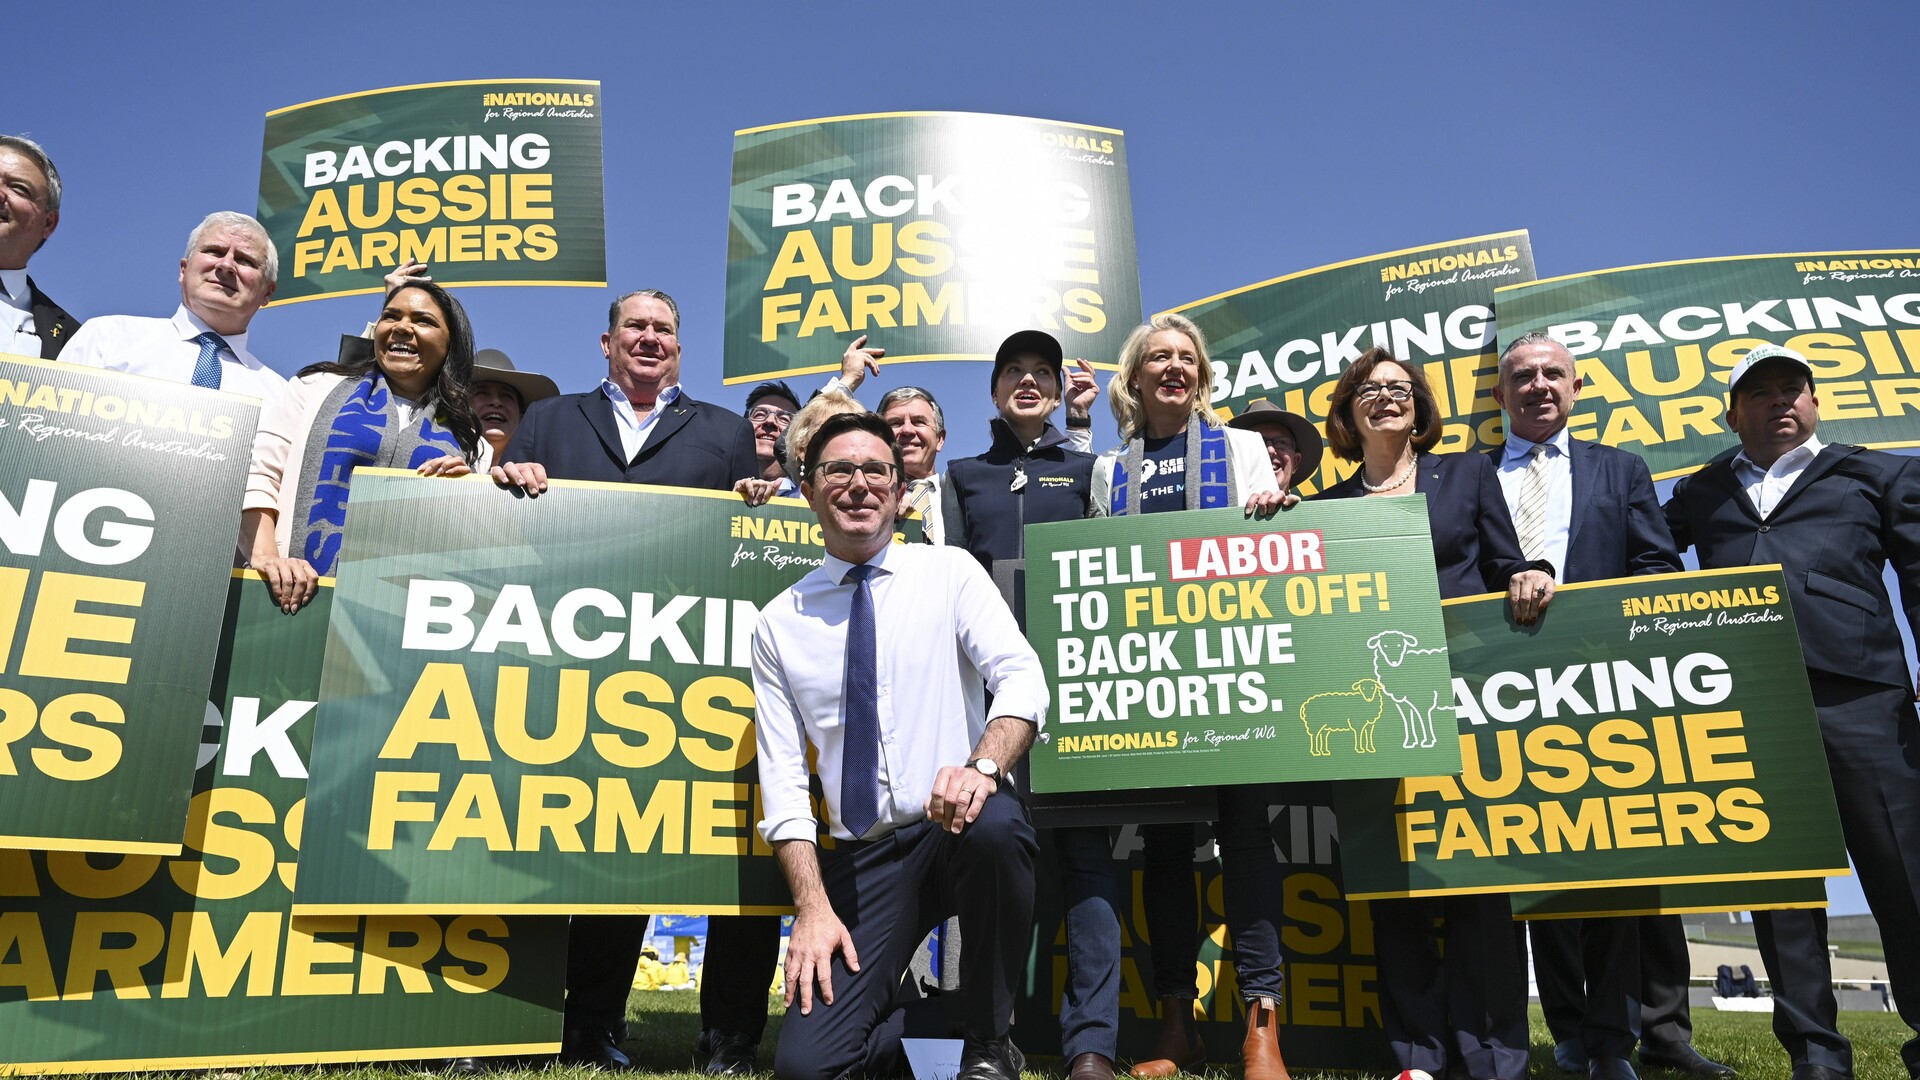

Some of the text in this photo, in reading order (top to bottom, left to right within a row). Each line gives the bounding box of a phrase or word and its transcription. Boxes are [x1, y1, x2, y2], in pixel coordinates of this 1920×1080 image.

[484, 107, 594, 123] for Regional Australia
[490, 92, 594, 107] NATIONALS
[303, 133, 550, 188] BACKING
[1040, 132, 1114, 154] ONALS
[296, 173, 554, 238] AUSSIE
[771, 174, 1090, 228] BACKG
[293, 224, 558, 278] FARMERS
[1381, 245, 1519, 283] THE NATIONALS
[1805, 258, 1920, 272] NATION
[1385, 264, 1521, 301] for Regional Australia
[1803, 273, 1826, 285] for
[1829, 270, 1895, 283] Regional
[1209, 304, 1496, 404] BACKING
[0, 378, 234, 440] NATIONALS
[18, 412, 120, 442] Regional
[122, 429, 227, 462] Australia
[1159, 457, 1184, 467] KEE
[1150, 486, 1174, 497] THE
[1159, 464, 1184, 475] SHE
[731, 515, 742, 538] THE
[731, 543, 757, 568] for
[1051, 531, 1323, 588] TELL LABOR
[1053, 572, 1391, 632] TO FLOCK OFF!
[1622, 585, 1781, 618] THE NATIONALS
[1629, 609, 1784, 641] for Regional Australia
[1057, 622, 1296, 677] BACK LIVE
[1058, 672, 1284, 724] EXPORTS.
[1450, 652, 1733, 726] ACKING
[377, 662, 759, 772] AUSS
[1057, 725, 1277, 753] THE NATIONALS for Regional WA
[367, 771, 774, 856] FARME
[1395, 787, 1771, 862] FARMERS
[0, 911, 510, 1002] ARMERS
